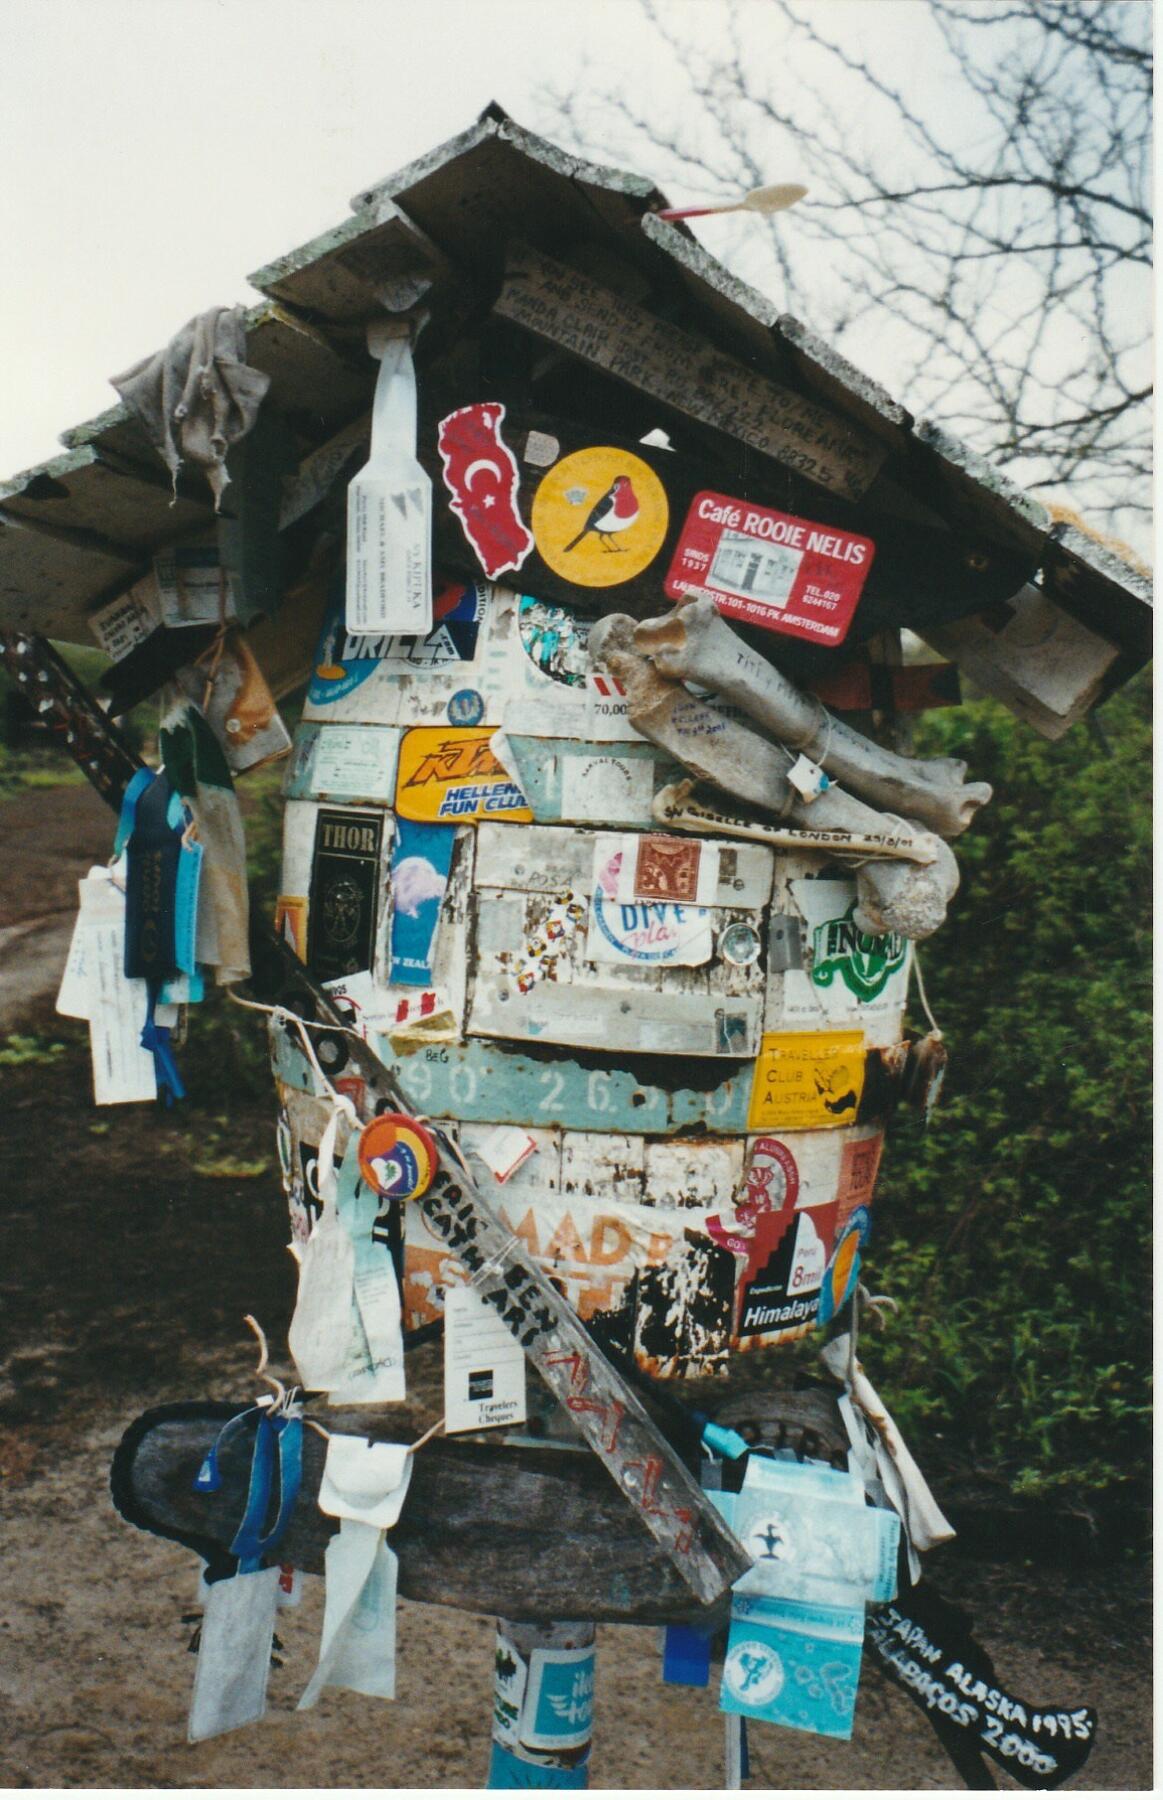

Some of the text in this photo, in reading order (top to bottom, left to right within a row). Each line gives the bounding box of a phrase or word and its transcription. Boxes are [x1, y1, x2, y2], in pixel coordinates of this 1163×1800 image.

[538, 276, 573, 305] AND
[573, 294, 620, 330] SEND
[514, 303, 600, 361] MOUNTAIN
[707, 407, 770, 451] MEXICO
[699, 499, 866, 565] Café ROOIE NELIS
[682, 558, 707, 571] 1937
[780, 612, 840, 638] AMSTERDAM
[440, 800, 478, 816] FUN
[322, 823, 376, 852] THOR
[686, 807, 751, 829] GISELLE
[787, 829, 852, 844] LONDON
[621, 904, 687, 932] DIVE
[766, 1069, 803, 1084] CLUB
[764, 1092, 818, 1105] AUSTRIA
[744, 1298, 820, 1327] Himalaya
[478, 1412, 513, 1424] Cheques
[479, 1401, 518, 1412] Travelers
[879, 1607, 942, 1663] JAPAN
[945, 1663, 1027, 1728] ALASKA
[981, 1714, 1059, 1775] 2000
